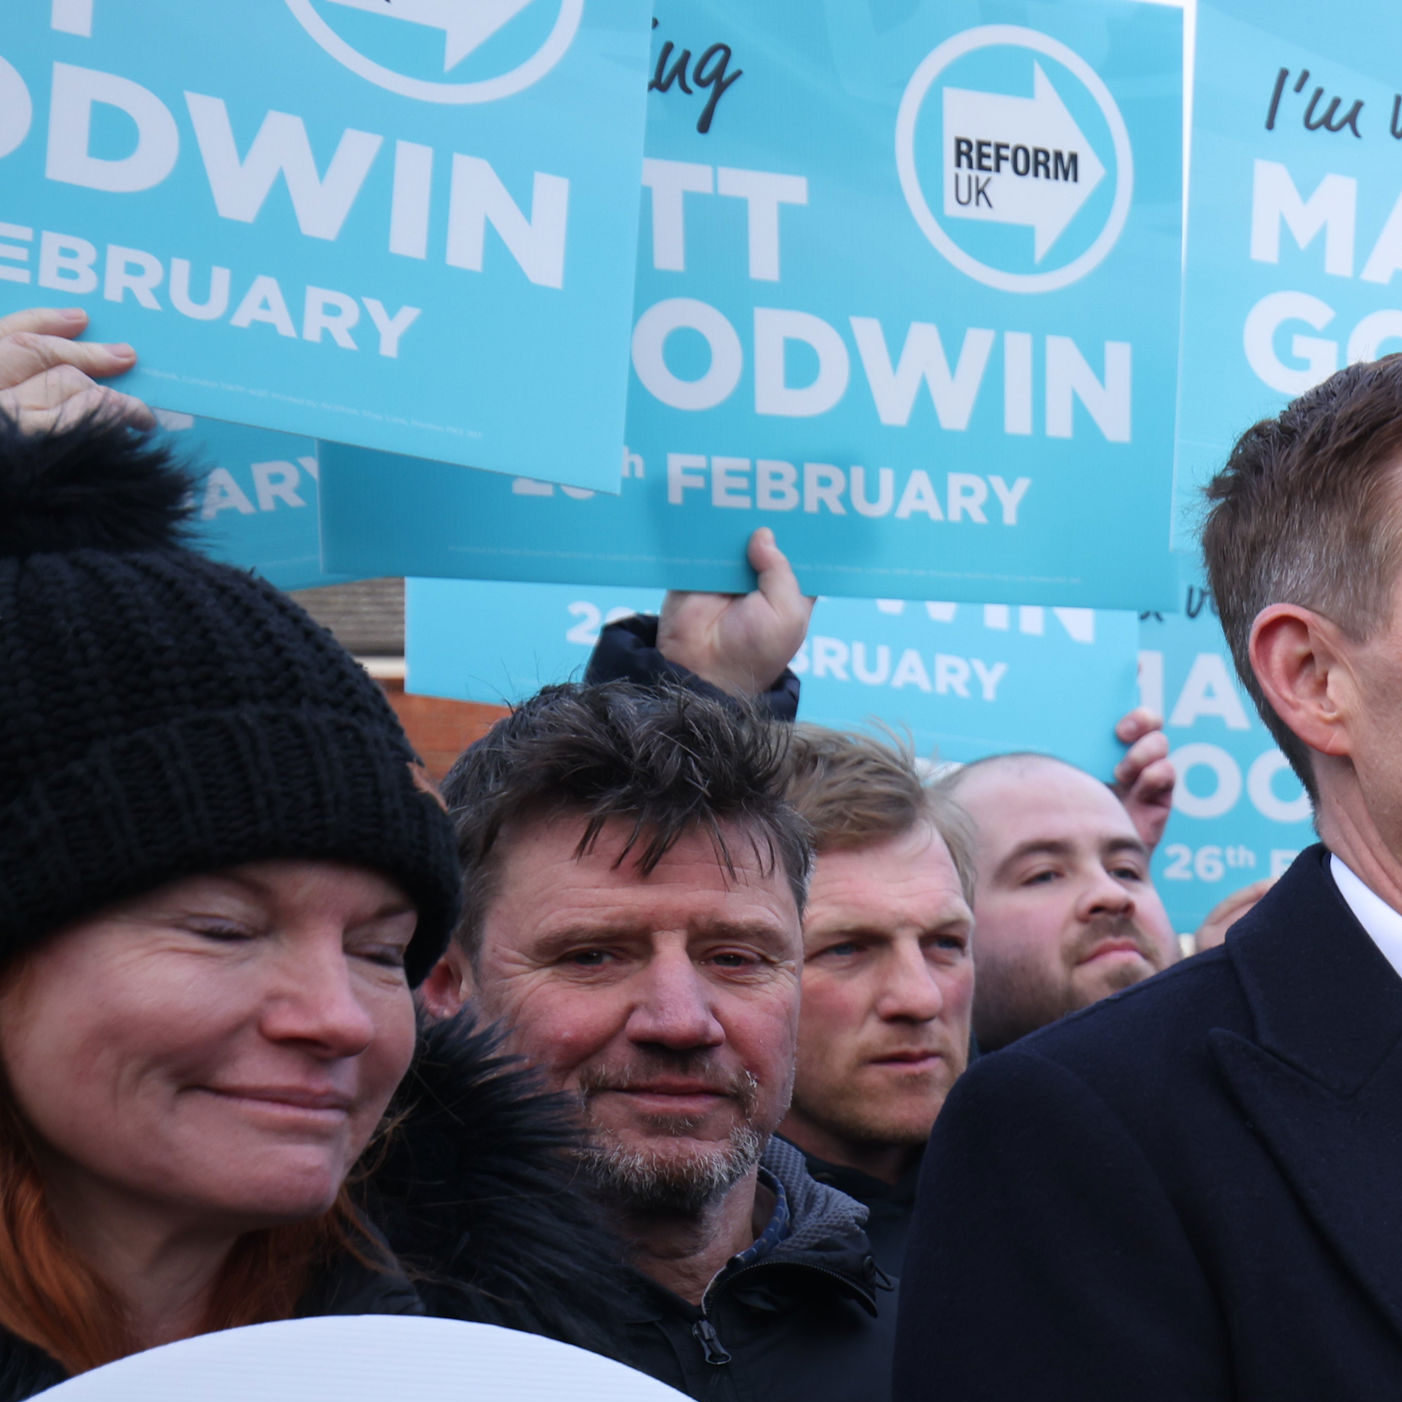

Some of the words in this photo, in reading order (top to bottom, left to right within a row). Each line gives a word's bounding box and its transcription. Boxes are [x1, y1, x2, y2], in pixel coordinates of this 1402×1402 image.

[1266, 68, 1364, 139] I'm
[0, 55, 569, 290] DWIN
[953, 136, 1079, 184] REFORM
[954, 172, 993, 209] UK
[667, 452, 1030, 526] FEBRUARY
[1163, 843, 1256, 882] 26th
